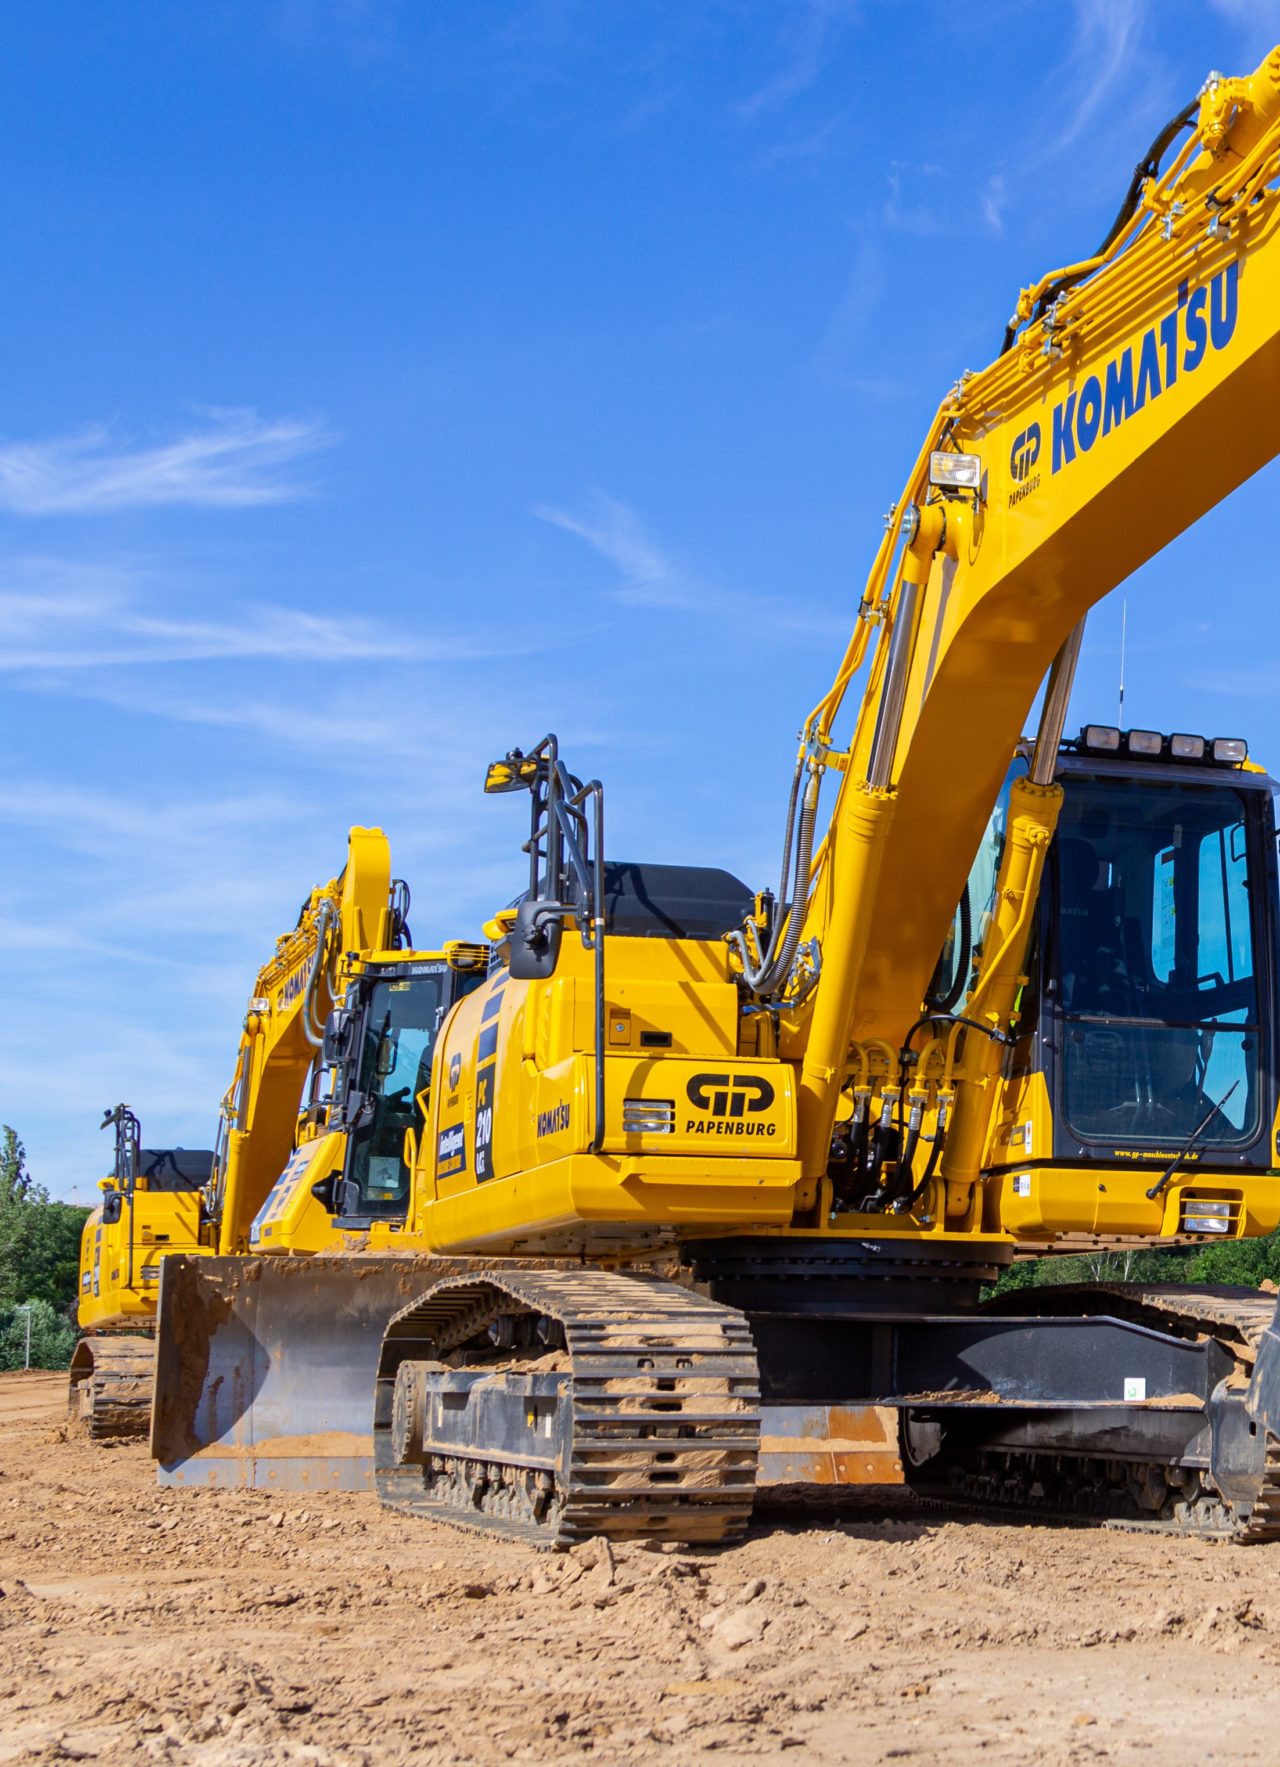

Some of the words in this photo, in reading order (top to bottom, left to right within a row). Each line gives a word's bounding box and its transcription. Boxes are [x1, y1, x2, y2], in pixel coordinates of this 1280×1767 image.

[1052, 260, 1238, 475] KOMATSU
[1008, 473, 1041, 509] PAPENBURG
[411, 963, 448, 975] KOMATSU
[476, 1107, 492, 1148] 210
[537, 1098, 570, 1139] KOMATSU
[686, 1120, 776, 1136] PAPENBURG
